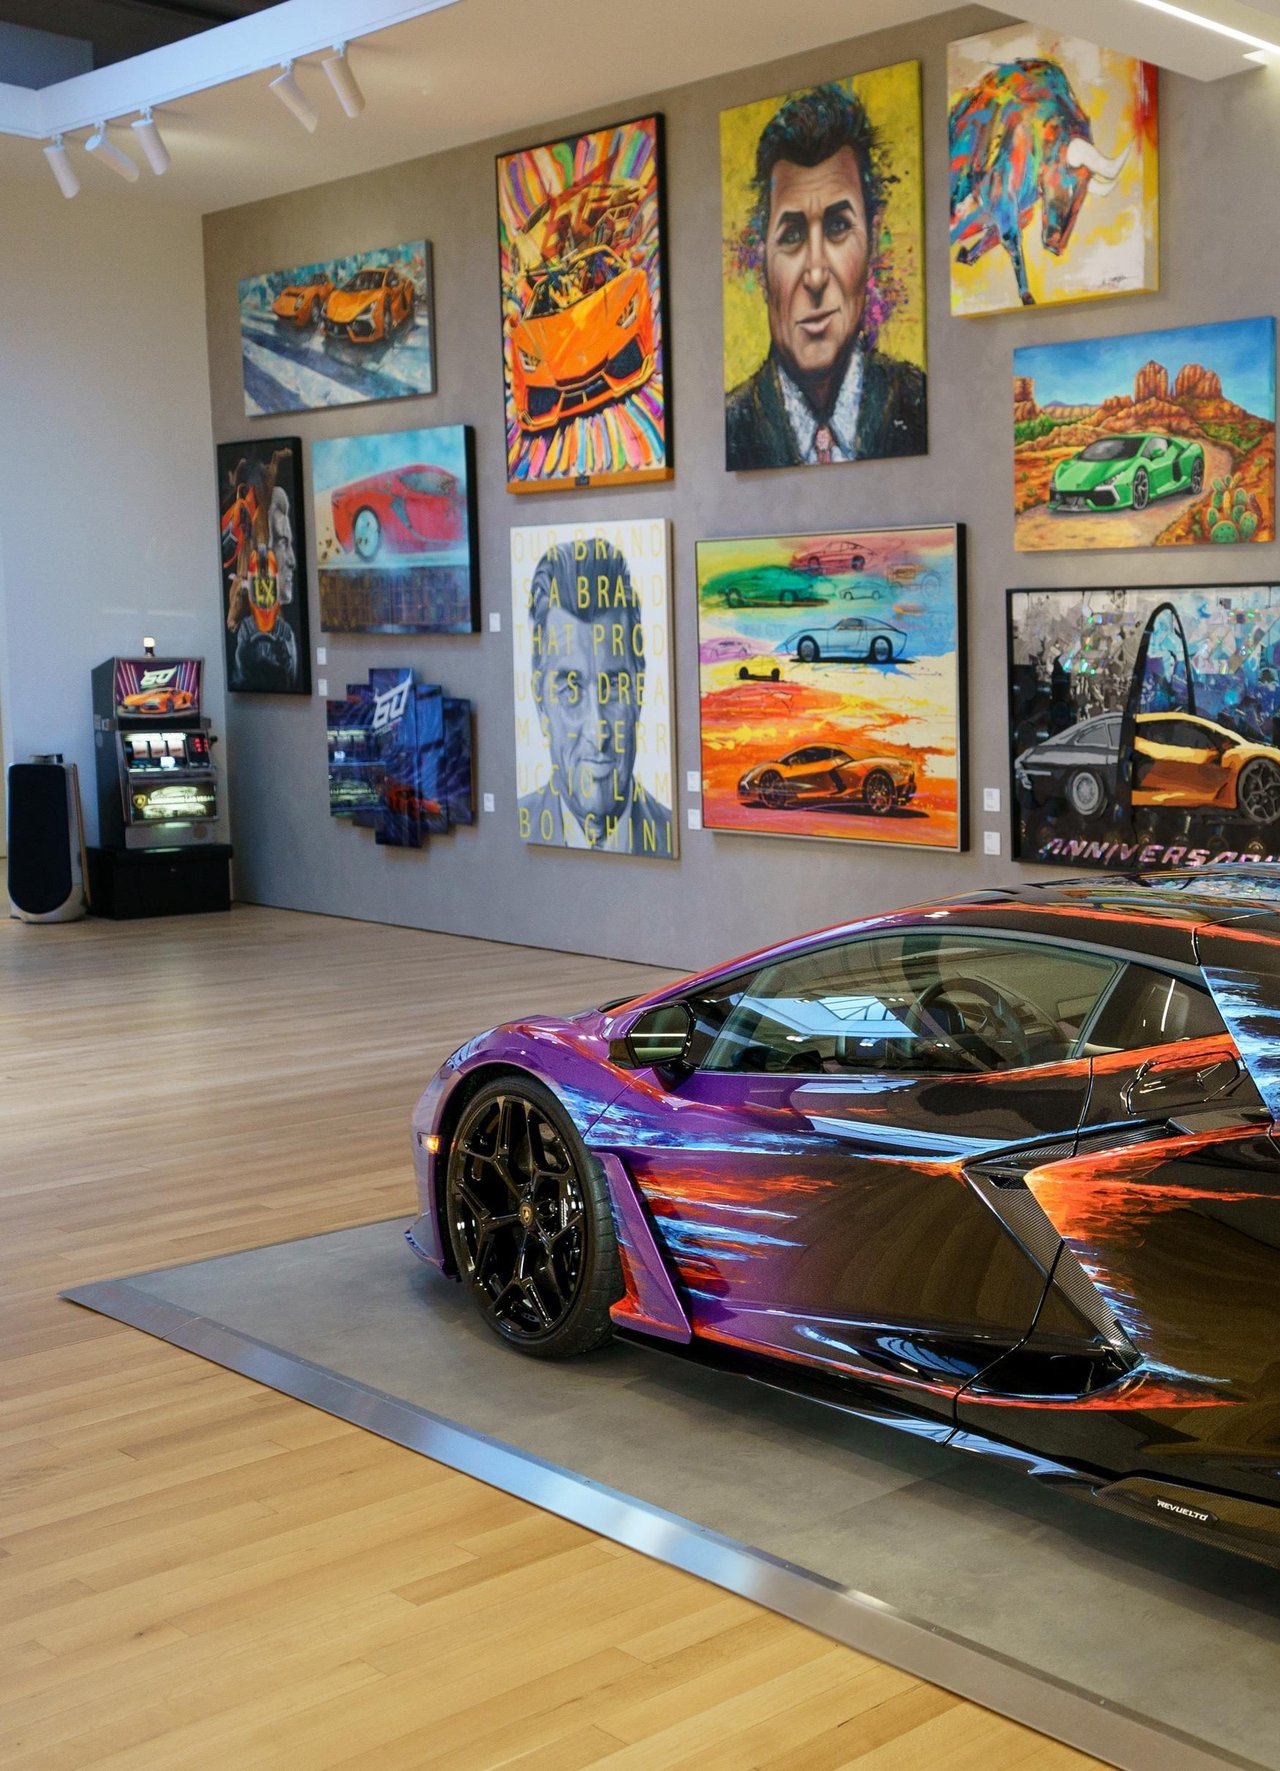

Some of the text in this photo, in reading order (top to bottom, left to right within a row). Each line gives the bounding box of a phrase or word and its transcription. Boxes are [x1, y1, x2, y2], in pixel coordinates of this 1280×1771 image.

[512, 524, 663, 562] OUR BRAND
[548, 577, 562, 609] A
[577, 573, 664, 609] BRAND
[516, 623, 666, 657] THAT PROD
[515, 670, 667, 706] UCES DREA
[516, 717, 552, 749] MS
[597, 719, 668, 754] FERR
[518, 763, 594, 798] UCCIO
[613, 768, 670, 804] LAM
[518, 807, 672, 854] BORGHINI
[1157, 1499, 1208, 1521] REVUELTO
